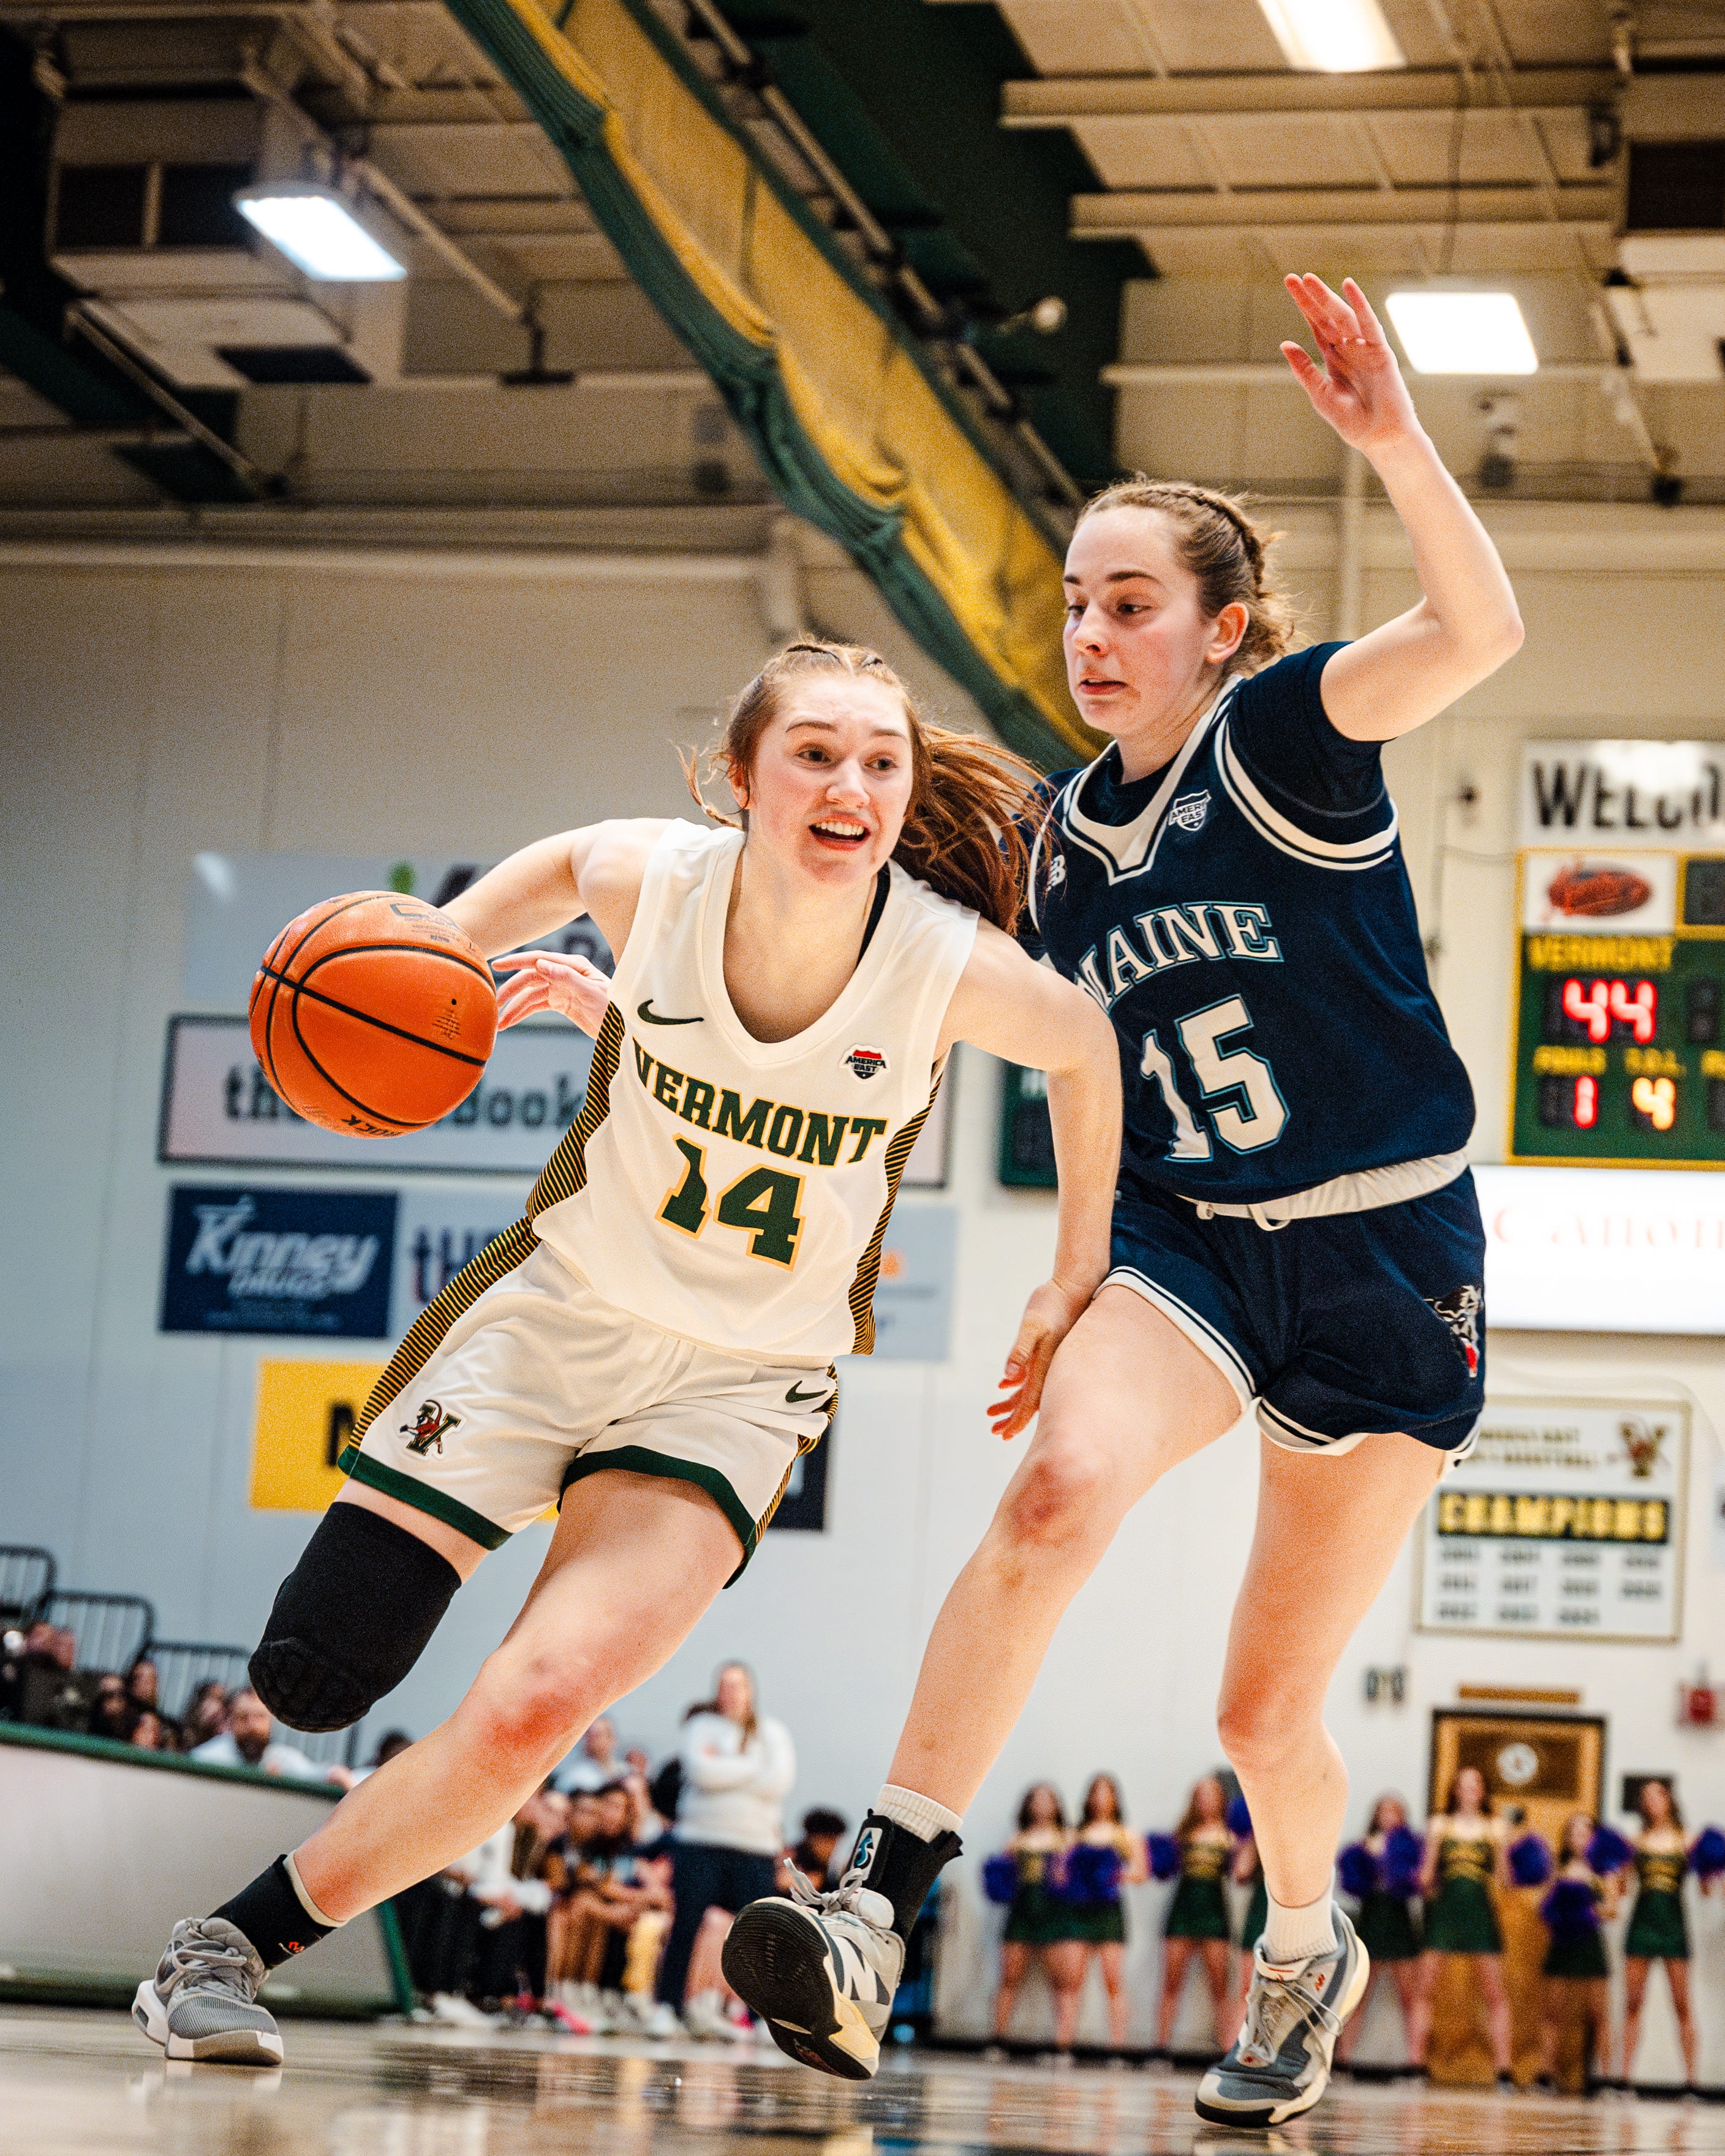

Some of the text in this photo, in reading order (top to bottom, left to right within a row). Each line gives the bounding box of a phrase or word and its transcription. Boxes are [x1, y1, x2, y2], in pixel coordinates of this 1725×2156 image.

[1171, 802, 1206, 819] AMER
[1182, 809, 1205, 823] EAS
[1074, 901, 1284, 1015] MAINE
[1562, 978, 1655, 1043] 44
[845, 1055, 887, 1069] AMERICA
[854, 1063, 877, 1072] EAST
[1141, 994, 1289, 1162] 15
[633, 1036, 889, 1167] VERMONT
[1631, 1076, 1676, 1131] 4
[655, 1133, 806, 1272] 14
[185, 1200, 378, 1294] Kinney
[1441, 1493, 1666, 1541] CHAMPIONS
